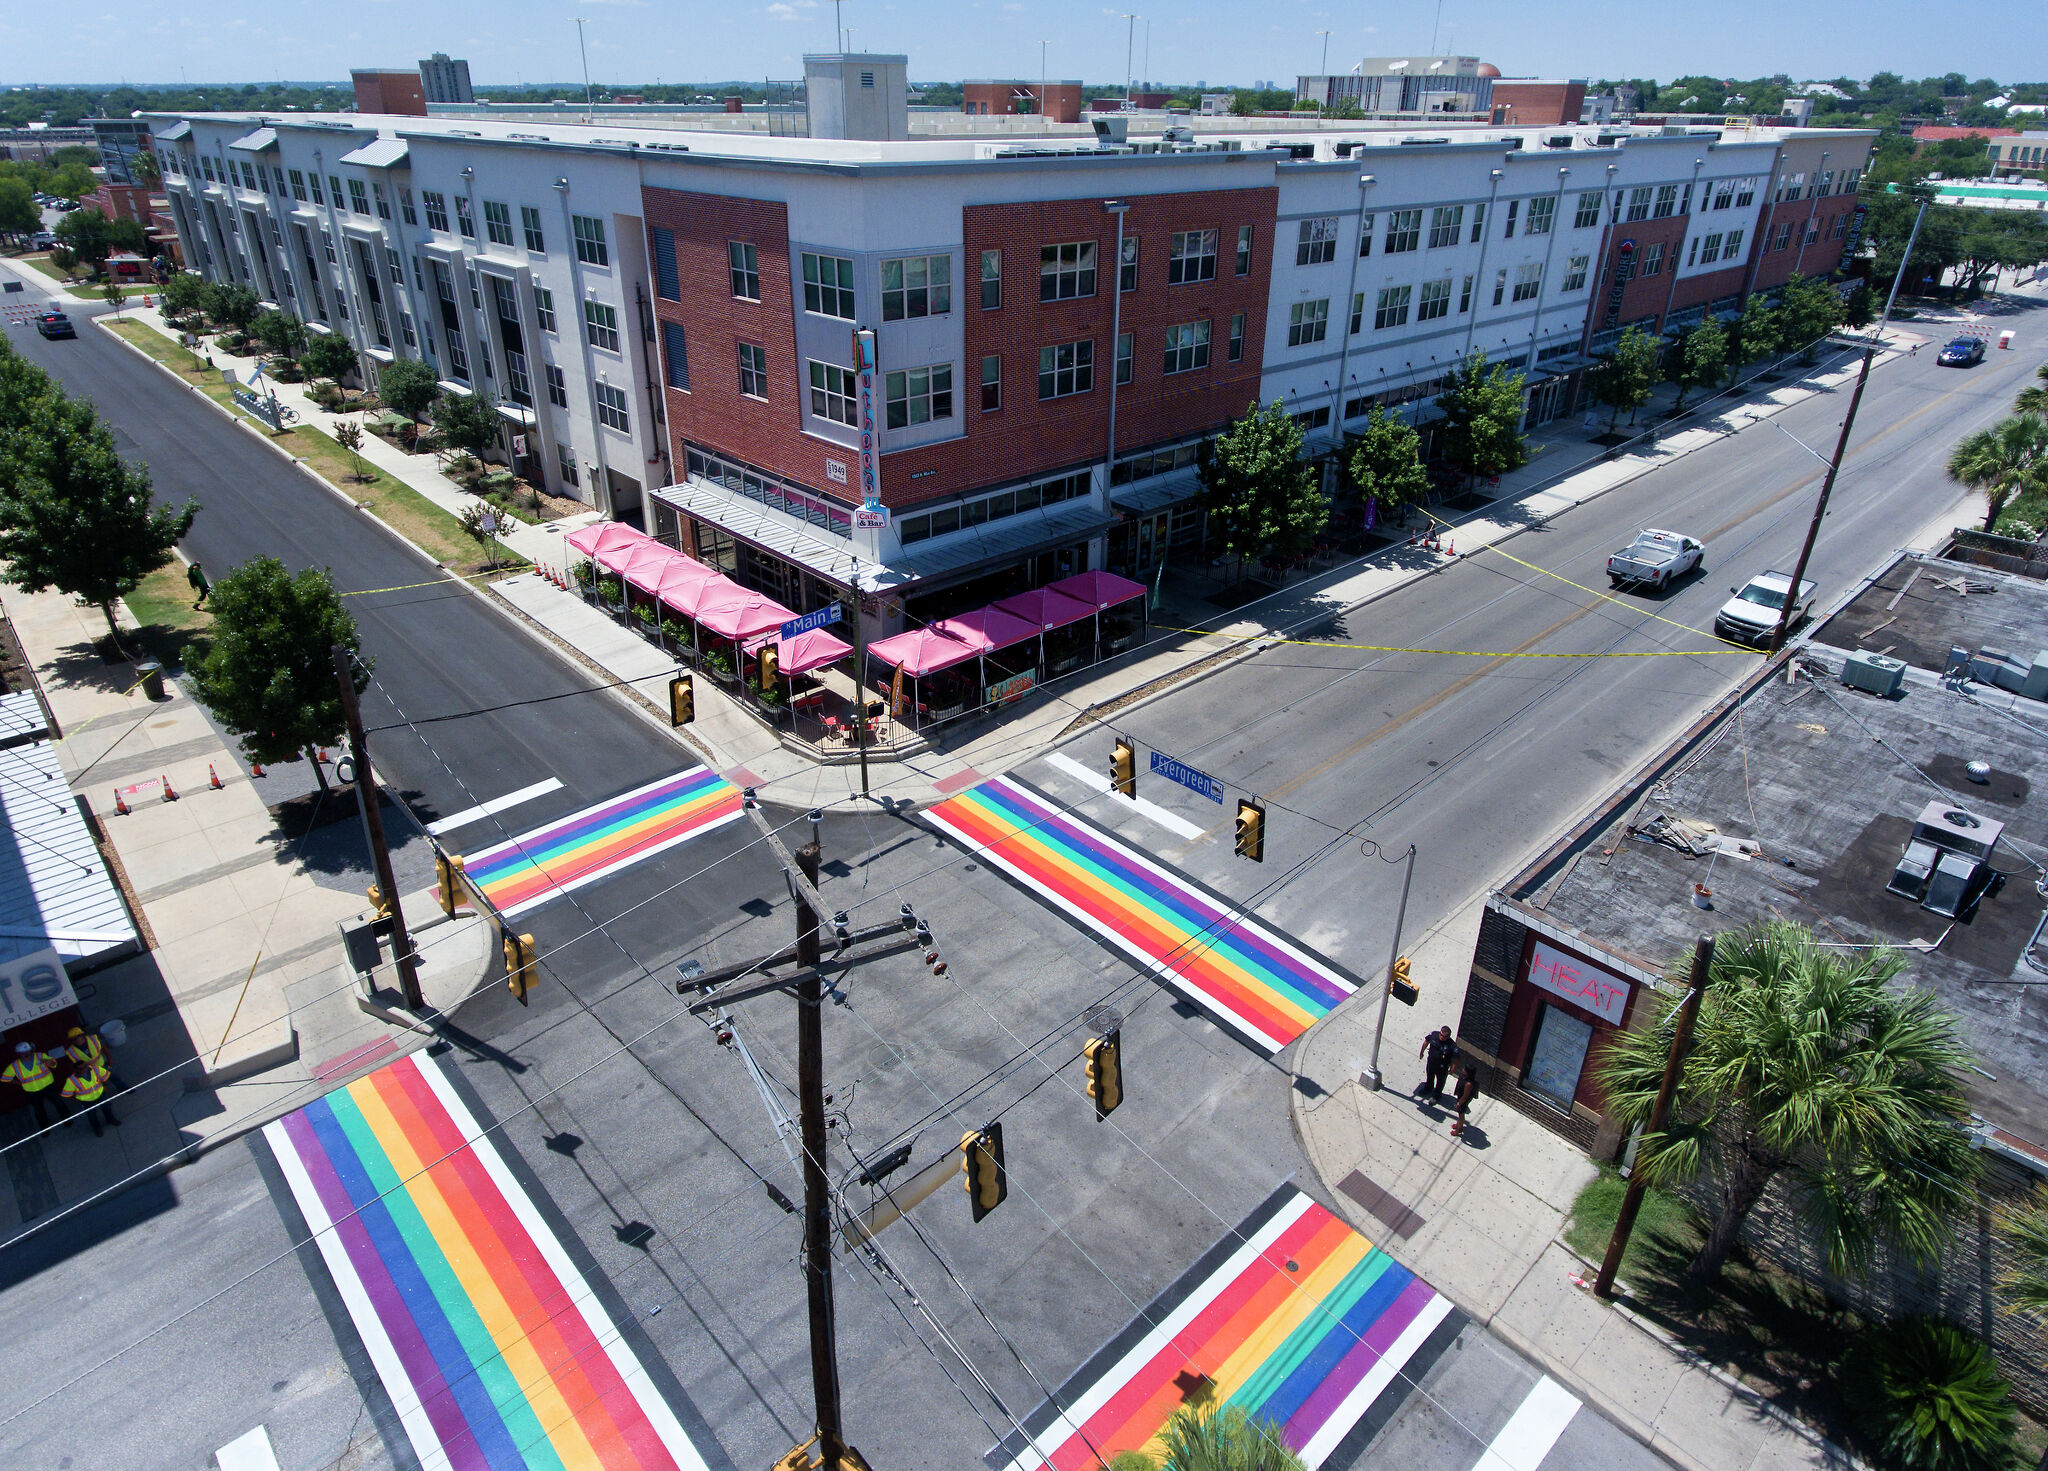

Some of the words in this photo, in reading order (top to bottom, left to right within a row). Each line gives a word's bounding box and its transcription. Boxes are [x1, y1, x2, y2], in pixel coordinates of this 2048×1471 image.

[1616, 251, 1632, 282] STORE
[1609, 286, 1624, 311] TECH
[1605, 311, 1618, 330] SAC
[831, 464, 845, 476] 1949
[858, 512, 879, 520] Café
[793, 612, 826, 633] Main
[1158, 755, 1210, 793] Evergreen
[1532, 953, 1624, 1011] HEAT
